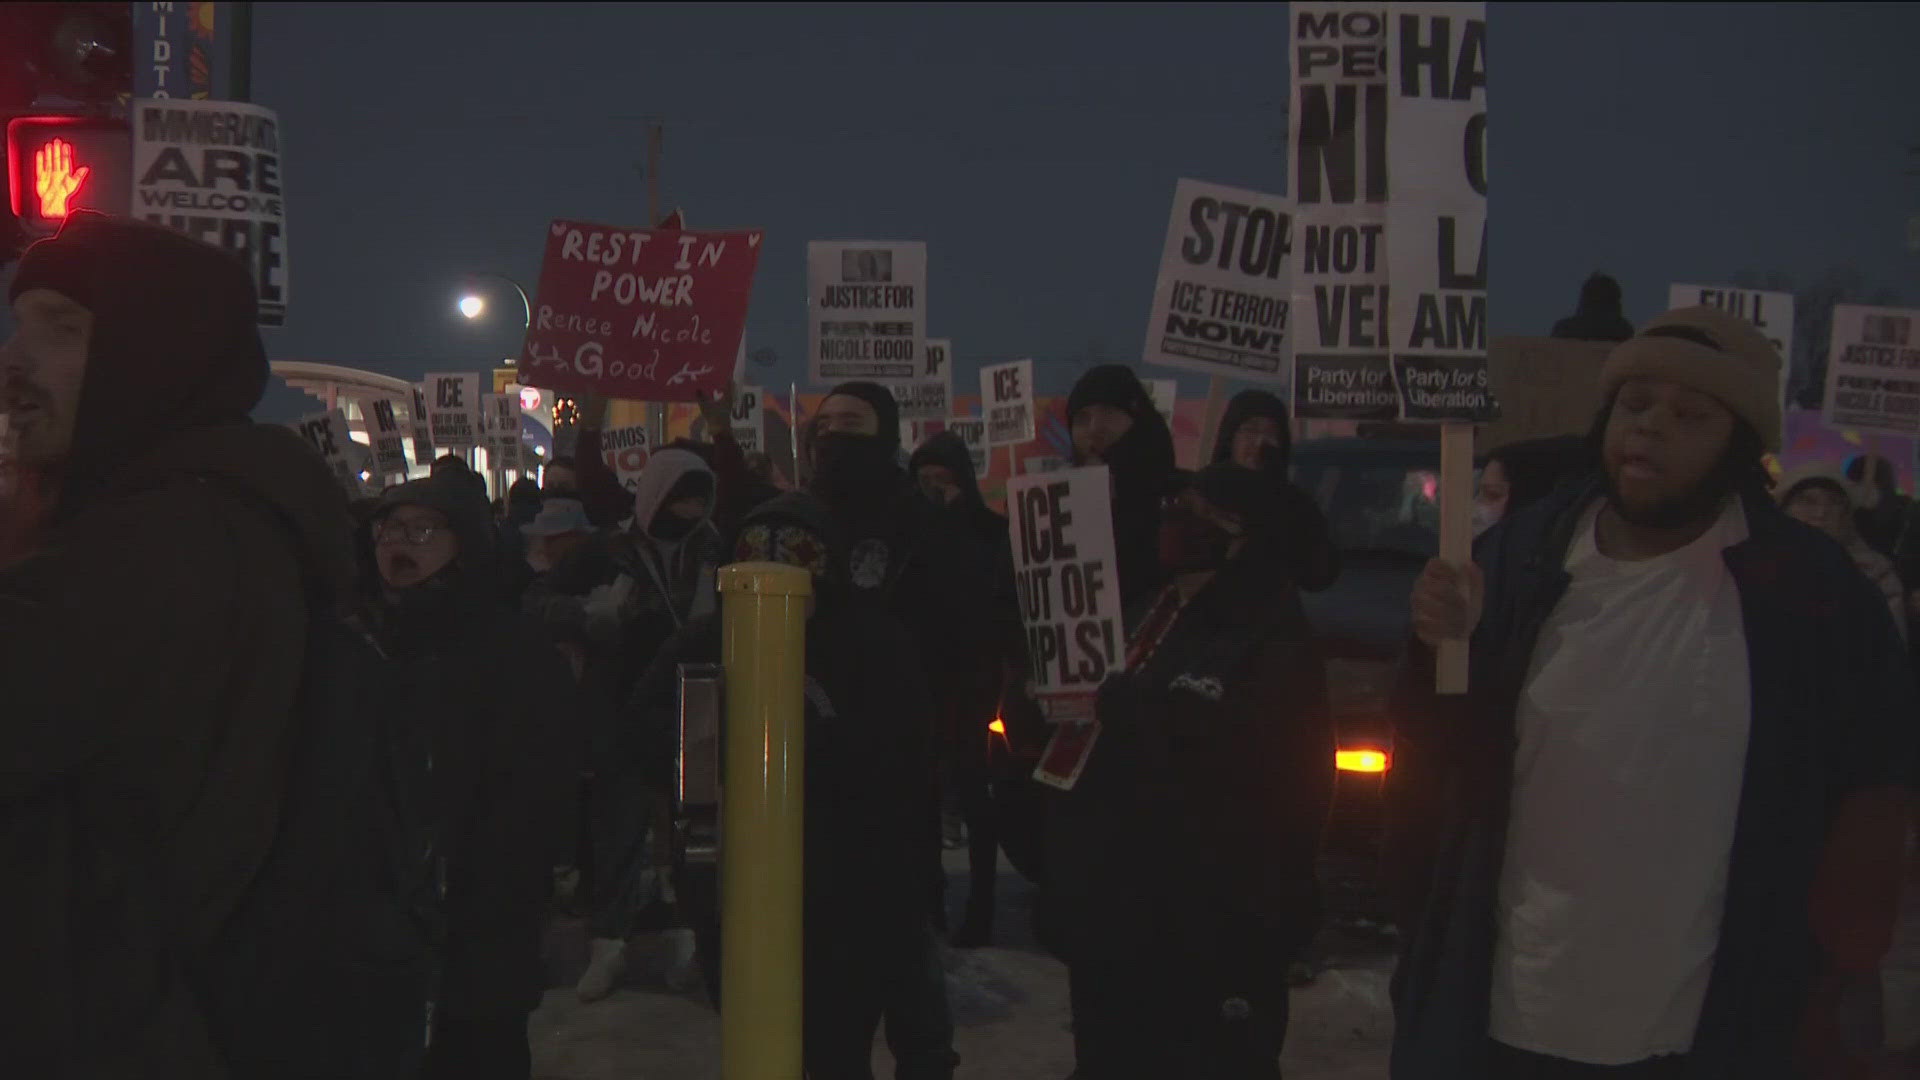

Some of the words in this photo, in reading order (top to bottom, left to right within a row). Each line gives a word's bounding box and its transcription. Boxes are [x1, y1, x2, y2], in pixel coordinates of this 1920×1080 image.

[1298, 12, 1387, 39] MO
[1298, 45, 1387, 77] PE
[140, 147, 281, 196] ARE
[140, 189, 281, 216] WELCOME
[562, 230, 651, 265] REST
[674, 236, 726, 270] IN
[1304, 225, 1382, 274] NOT
[591, 270, 694, 306] POWER
[821, 286, 883, 308] JUSTICE
[885, 286, 913, 308] FOR
[1170, 280, 1207, 315] ICE
[1210, 288, 1289, 330] TERROR
[537, 305, 612, 336] Renee
[632, 312, 712, 344] Nicole
[1165, 314, 1284, 353] NOW!
[574, 341, 659, 379] Good
[821, 339, 870, 360] NICOLE
[873, 339, 913, 360] GOOD
[437, 377, 463, 408] ICE
[994, 367, 1021, 401] ICE
[1308, 367, 1352, 388] Party
[1361, 367, 1385, 384] for
[1406, 367, 1449, 389] Party
[1452, 368, 1474, 385] for
[1410, 388, 1486, 408] Liberation
[1016, 481, 1077, 566] ICE
[1061, 560, 1104, 618] OF
